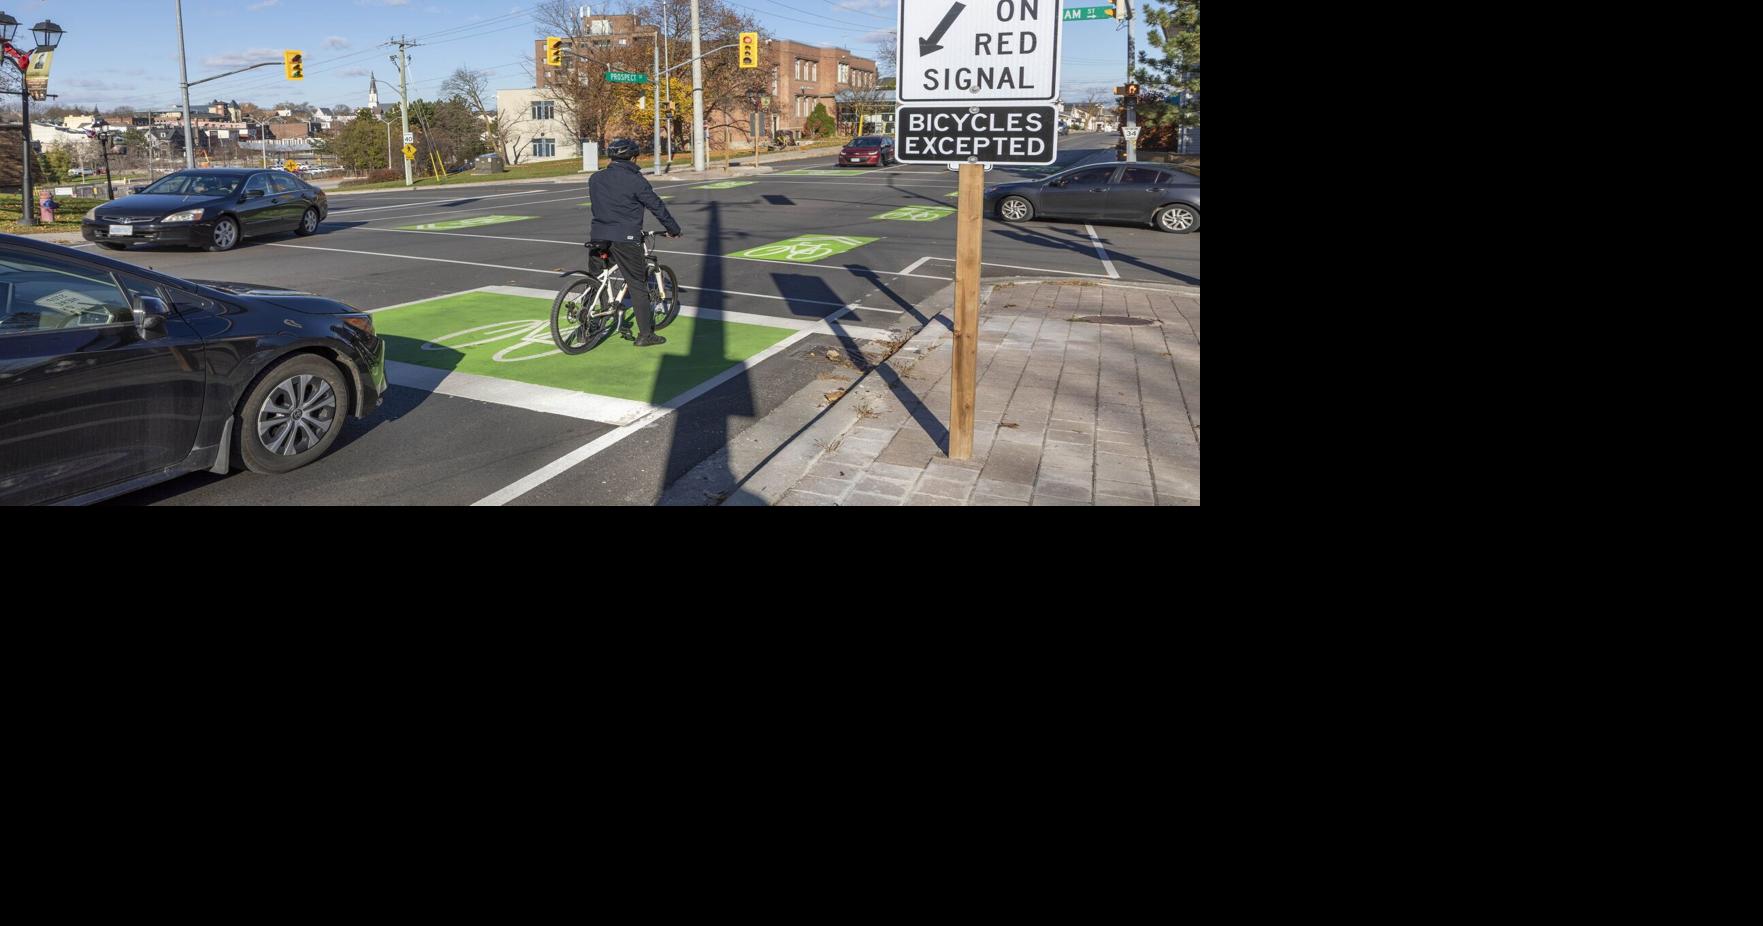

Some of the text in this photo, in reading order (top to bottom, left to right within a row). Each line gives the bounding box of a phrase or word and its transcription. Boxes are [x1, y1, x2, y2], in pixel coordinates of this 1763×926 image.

[996, 0, 1038, 22] ON
[975, 31, 1037, 56] RED
[610, 73, 637, 81] PROSPECT
[923, 66, 1035, 91] SIGNAL
[909, 113, 1042, 132] BICYCLES
[905, 136, 1045, 156] EXCEPTED
